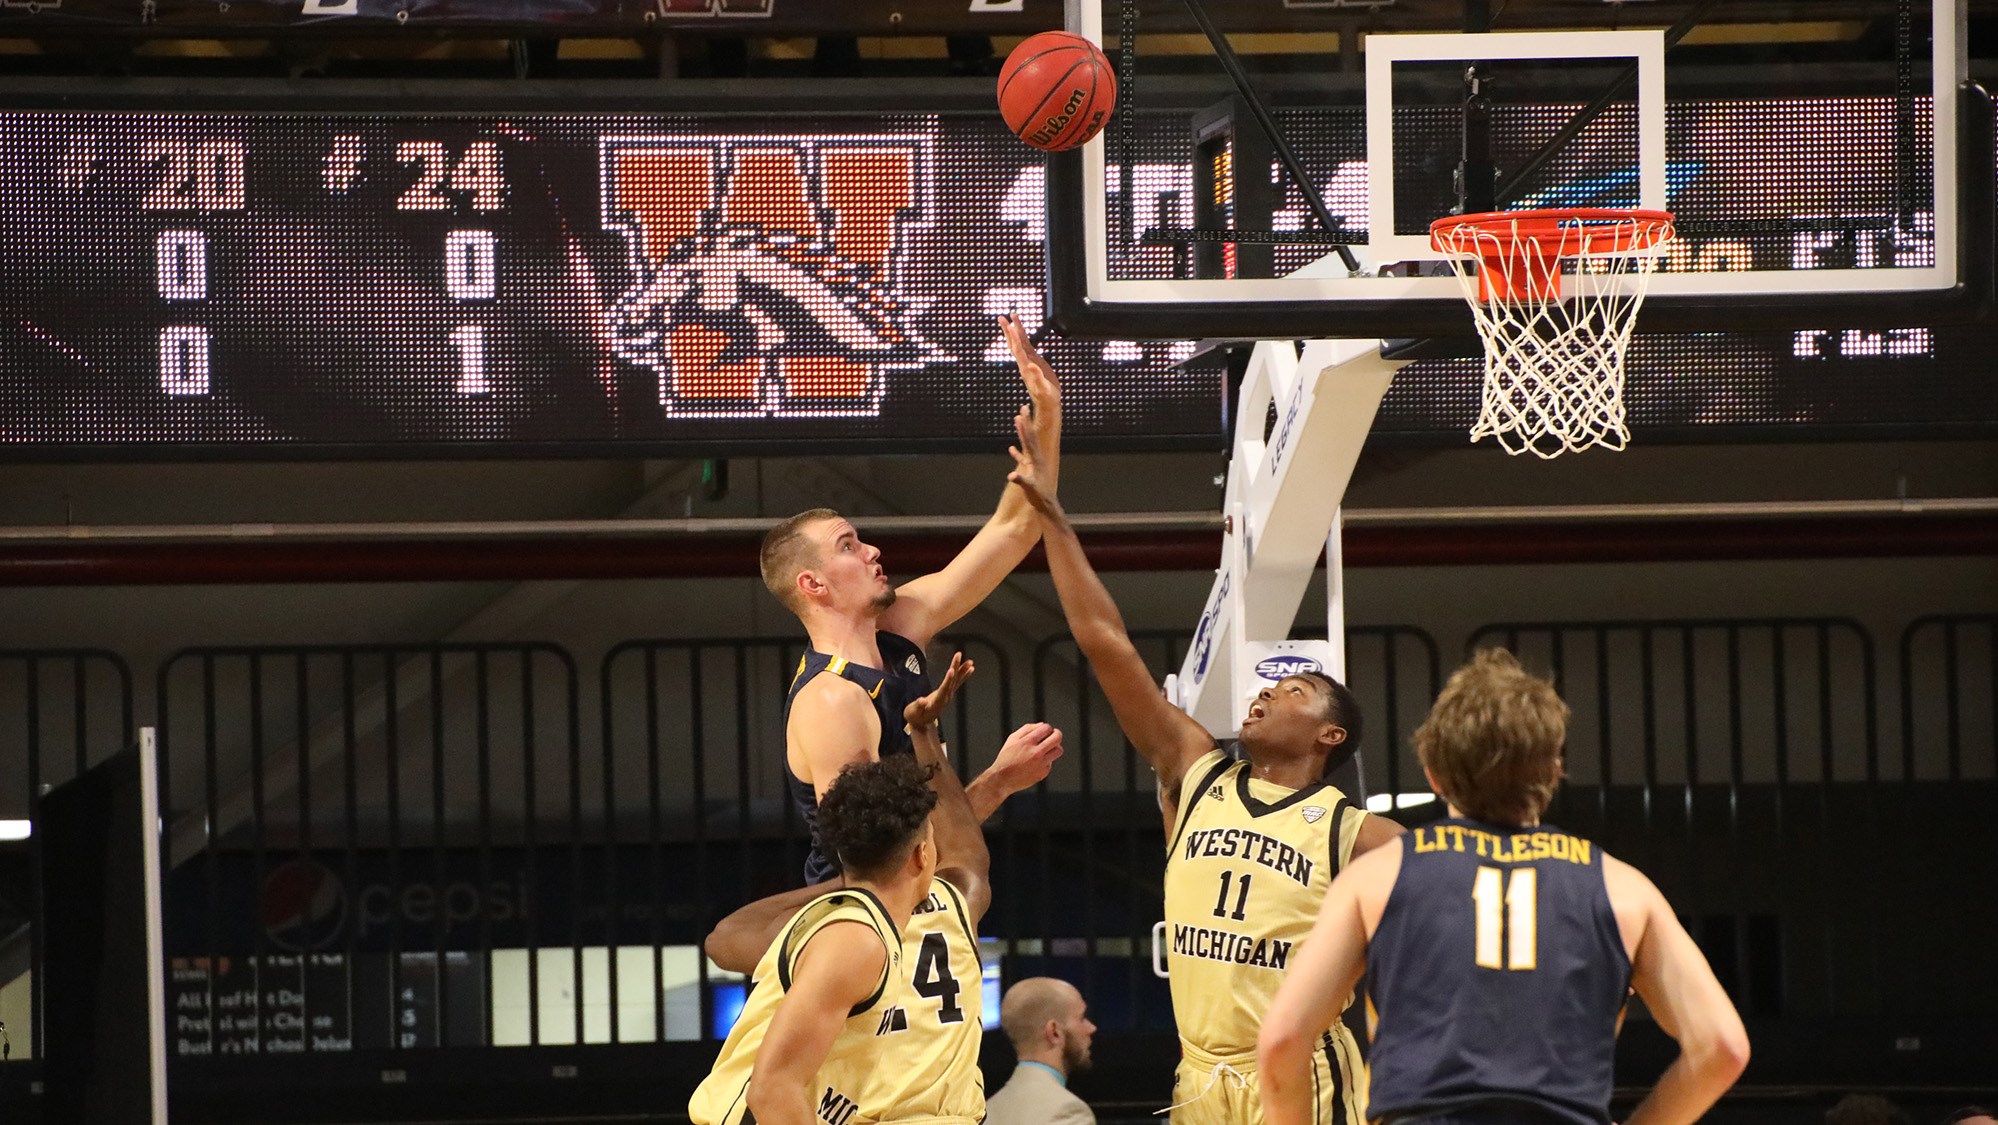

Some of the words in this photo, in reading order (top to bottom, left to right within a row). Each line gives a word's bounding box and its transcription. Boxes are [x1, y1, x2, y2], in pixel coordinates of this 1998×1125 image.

[1027, 87, 1086, 146] Wilson
[141, 141, 245, 210] 20
[396, 141, 502, 210] 24
[156, 229, 207, 300] 0
[445, 229, 496, 299] 0
[159, 326, 210, 395] 0
[449, 325, 490, 393] 1
[1271, 376, 1304, 477] LEGACY
[1185, 828, 1313, 887] WESTERN
[1413, 825, 1592, 865] LITTLESON
[357, 869, 528, 938] pepsi
[1213, 870, 1252, 921] 11
[1471, 865, 1537, 971] 11
[1173, 923, 1292, 970] MICHIGAN
